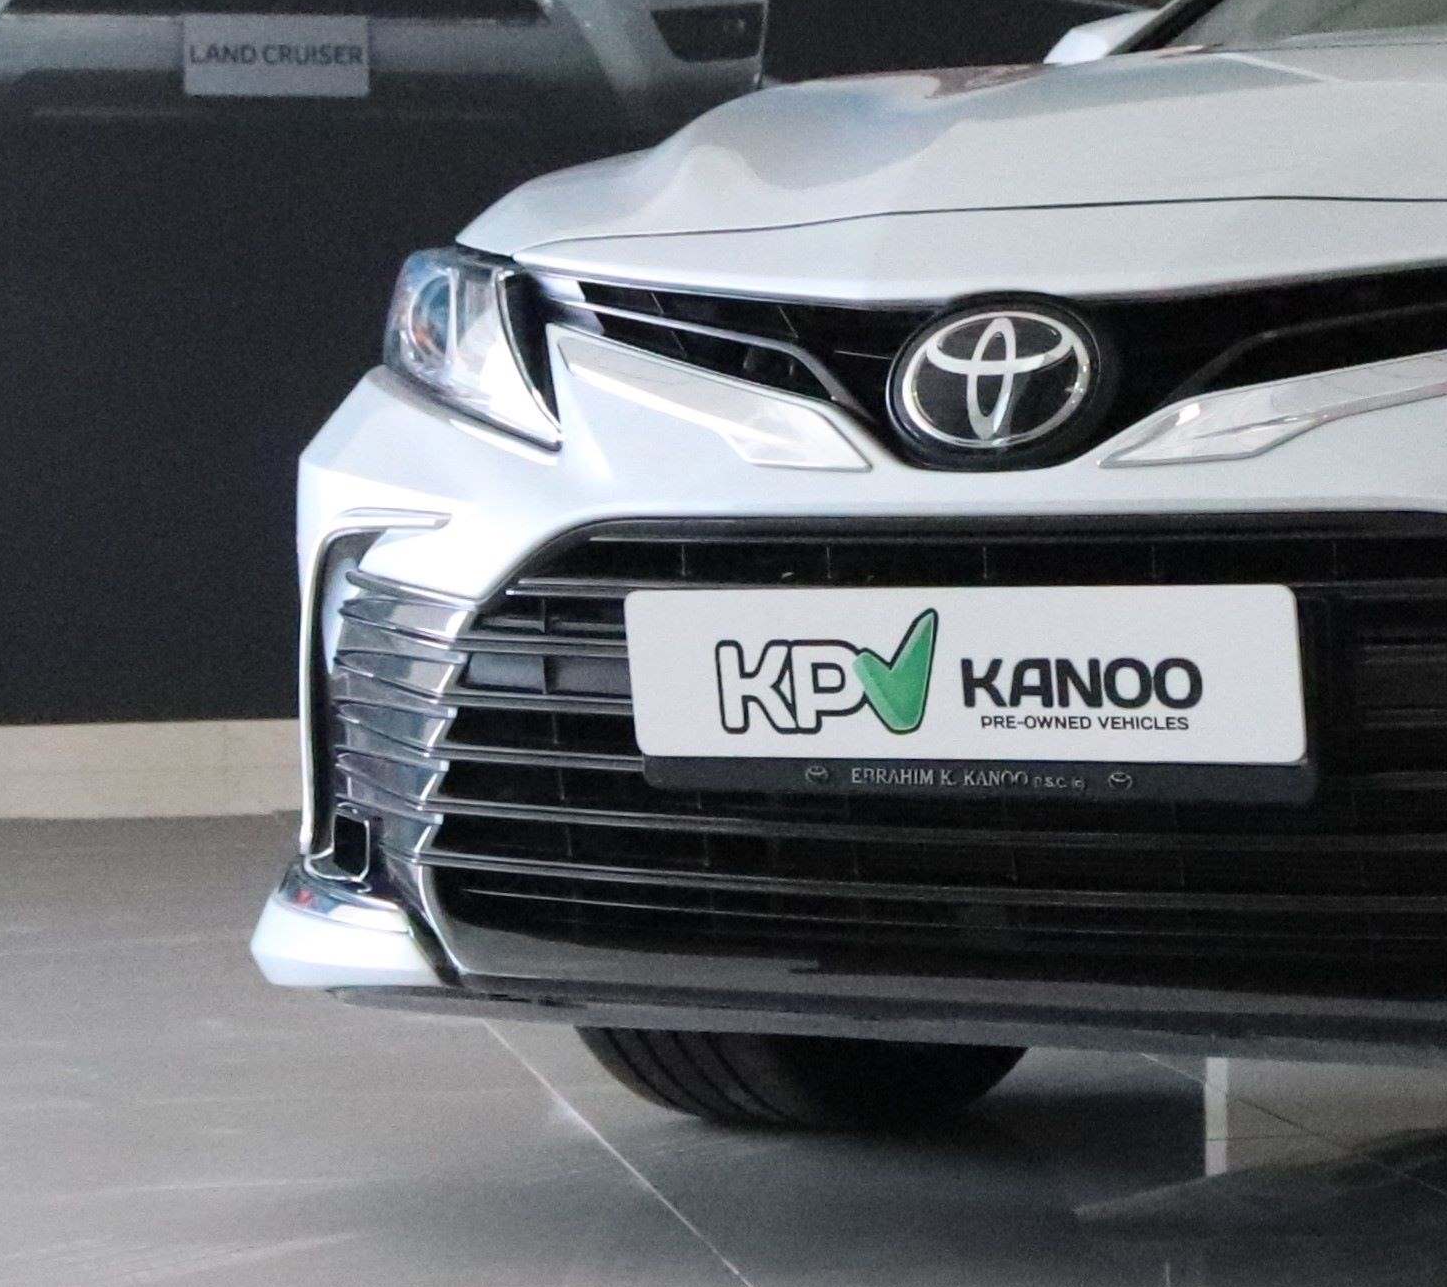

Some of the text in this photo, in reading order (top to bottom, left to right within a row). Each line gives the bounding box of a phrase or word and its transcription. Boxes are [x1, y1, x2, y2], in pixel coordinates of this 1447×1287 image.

[188, 43, 365, 65] LAND CRUISER
[960, 657, 1203, 709] KANOO
[980, 715, 1190, 731] PRE-OWNED VEHICLES
[851, 767, 934, 786] EBRAHIM
[963, 769, 1029, 788] KANOO
